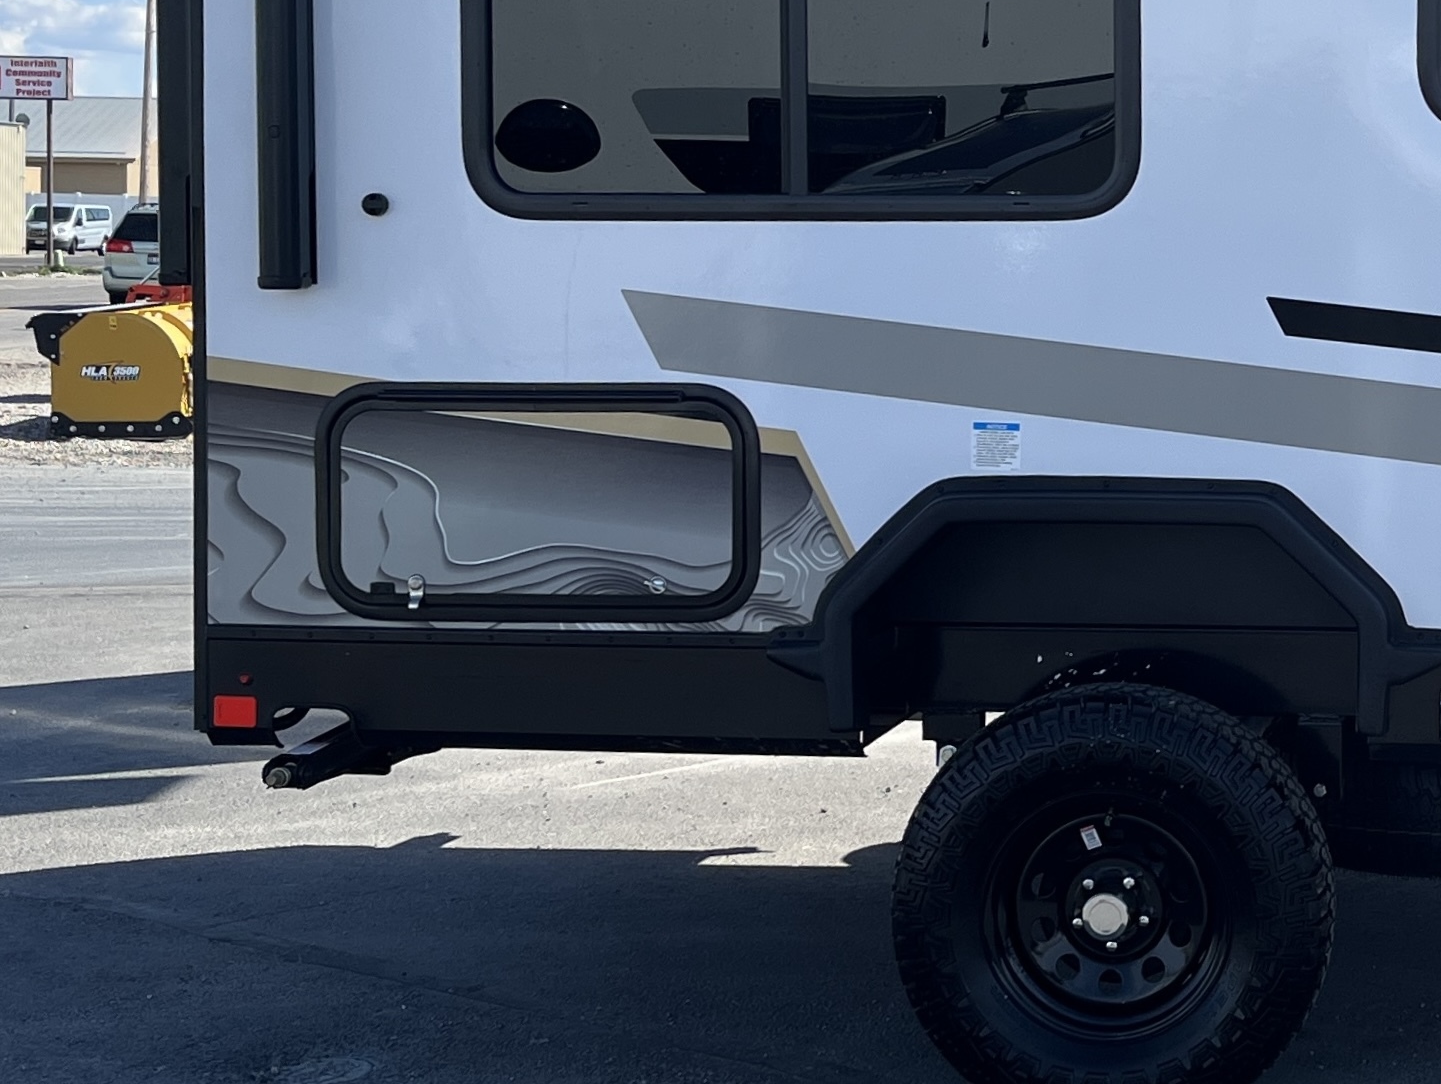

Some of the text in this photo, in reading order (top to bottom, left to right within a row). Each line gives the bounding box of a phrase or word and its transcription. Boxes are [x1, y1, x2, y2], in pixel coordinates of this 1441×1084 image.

[10, 59, 57, 68] Interfaith
[5, 68, 62, 78] Community
[15, 78, 53, 87] Service
[16, 88, 52, 96] Project
[81, 366, 107, 377] HLA
